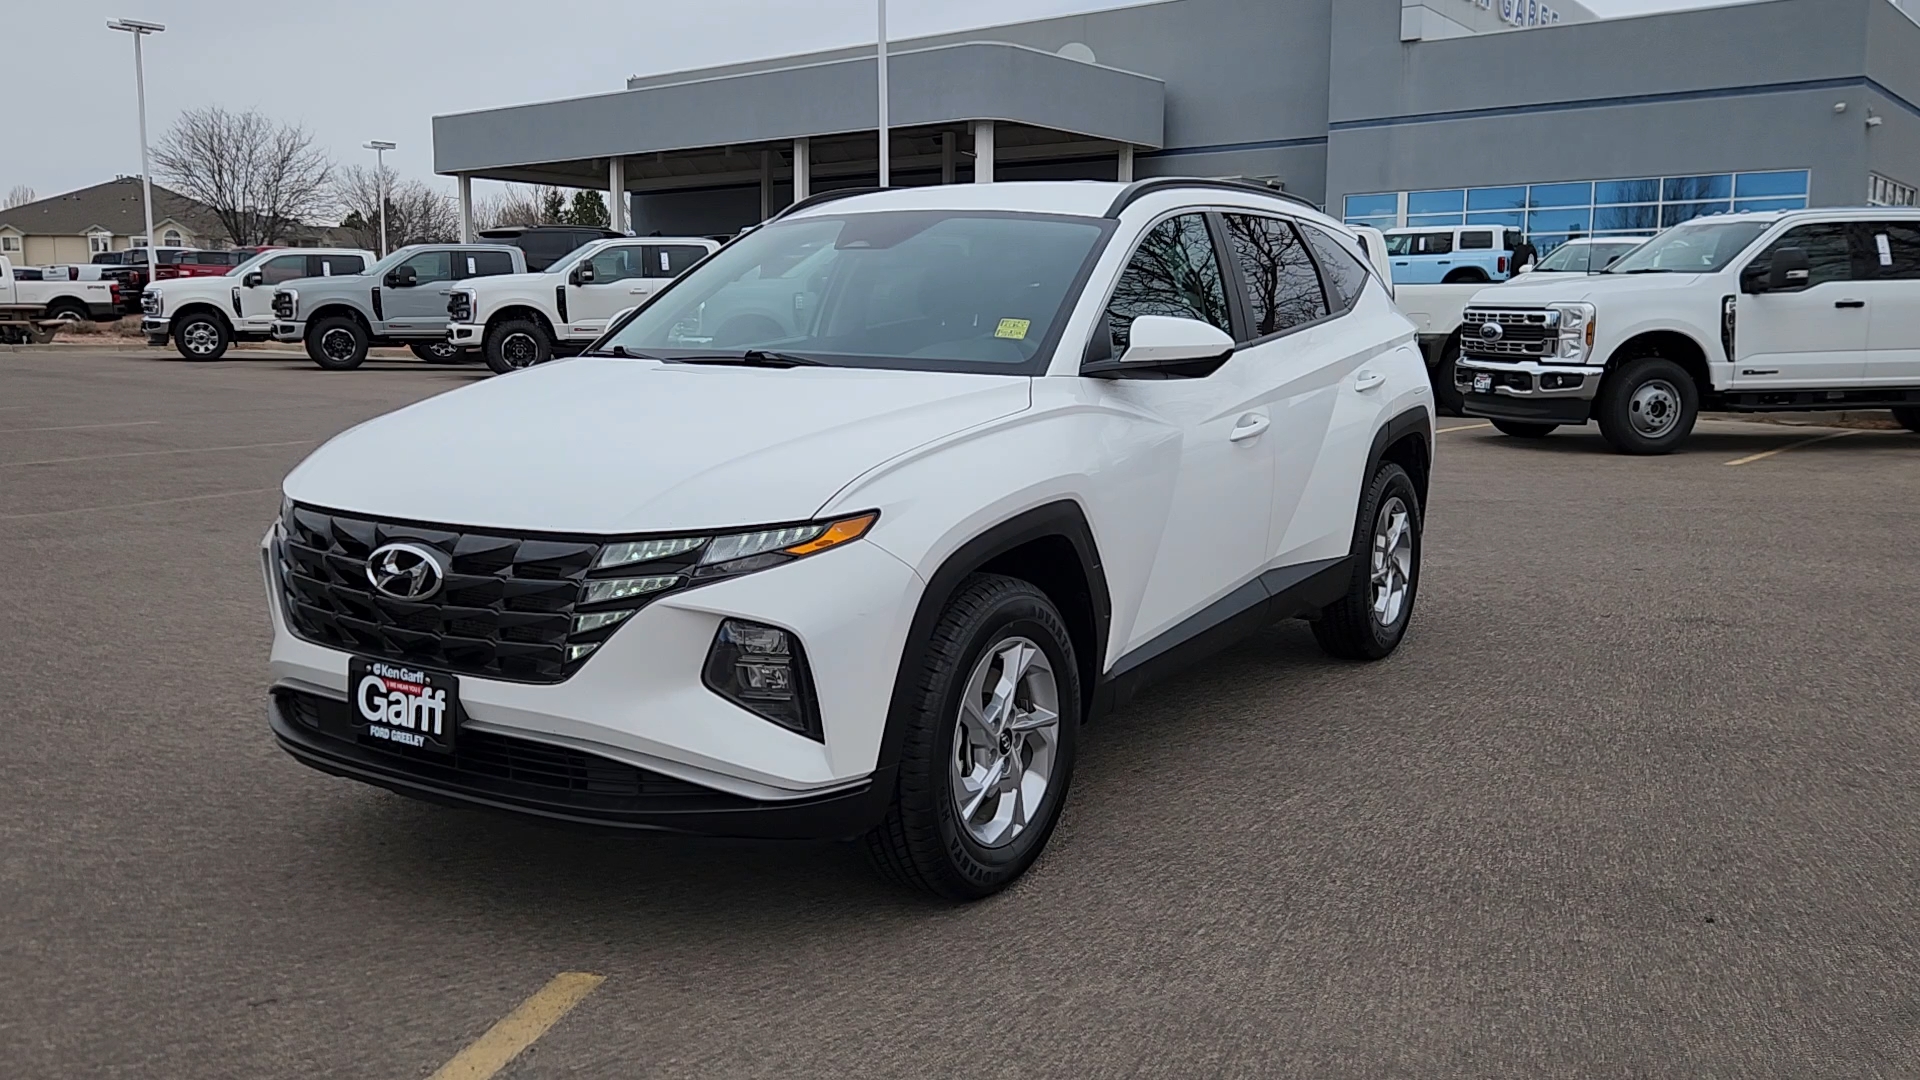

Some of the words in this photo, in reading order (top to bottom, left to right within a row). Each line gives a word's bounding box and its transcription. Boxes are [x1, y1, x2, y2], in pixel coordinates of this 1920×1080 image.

[381, 664, 399, 679] Ken
[400, 668, 424, 684] Garff
[409, 685, 418, 693] YOU
[358, 675, 446, 735] Garff
[370, 725, 390, 739] FORD
[391, 730, 425, 747] GREELEY
